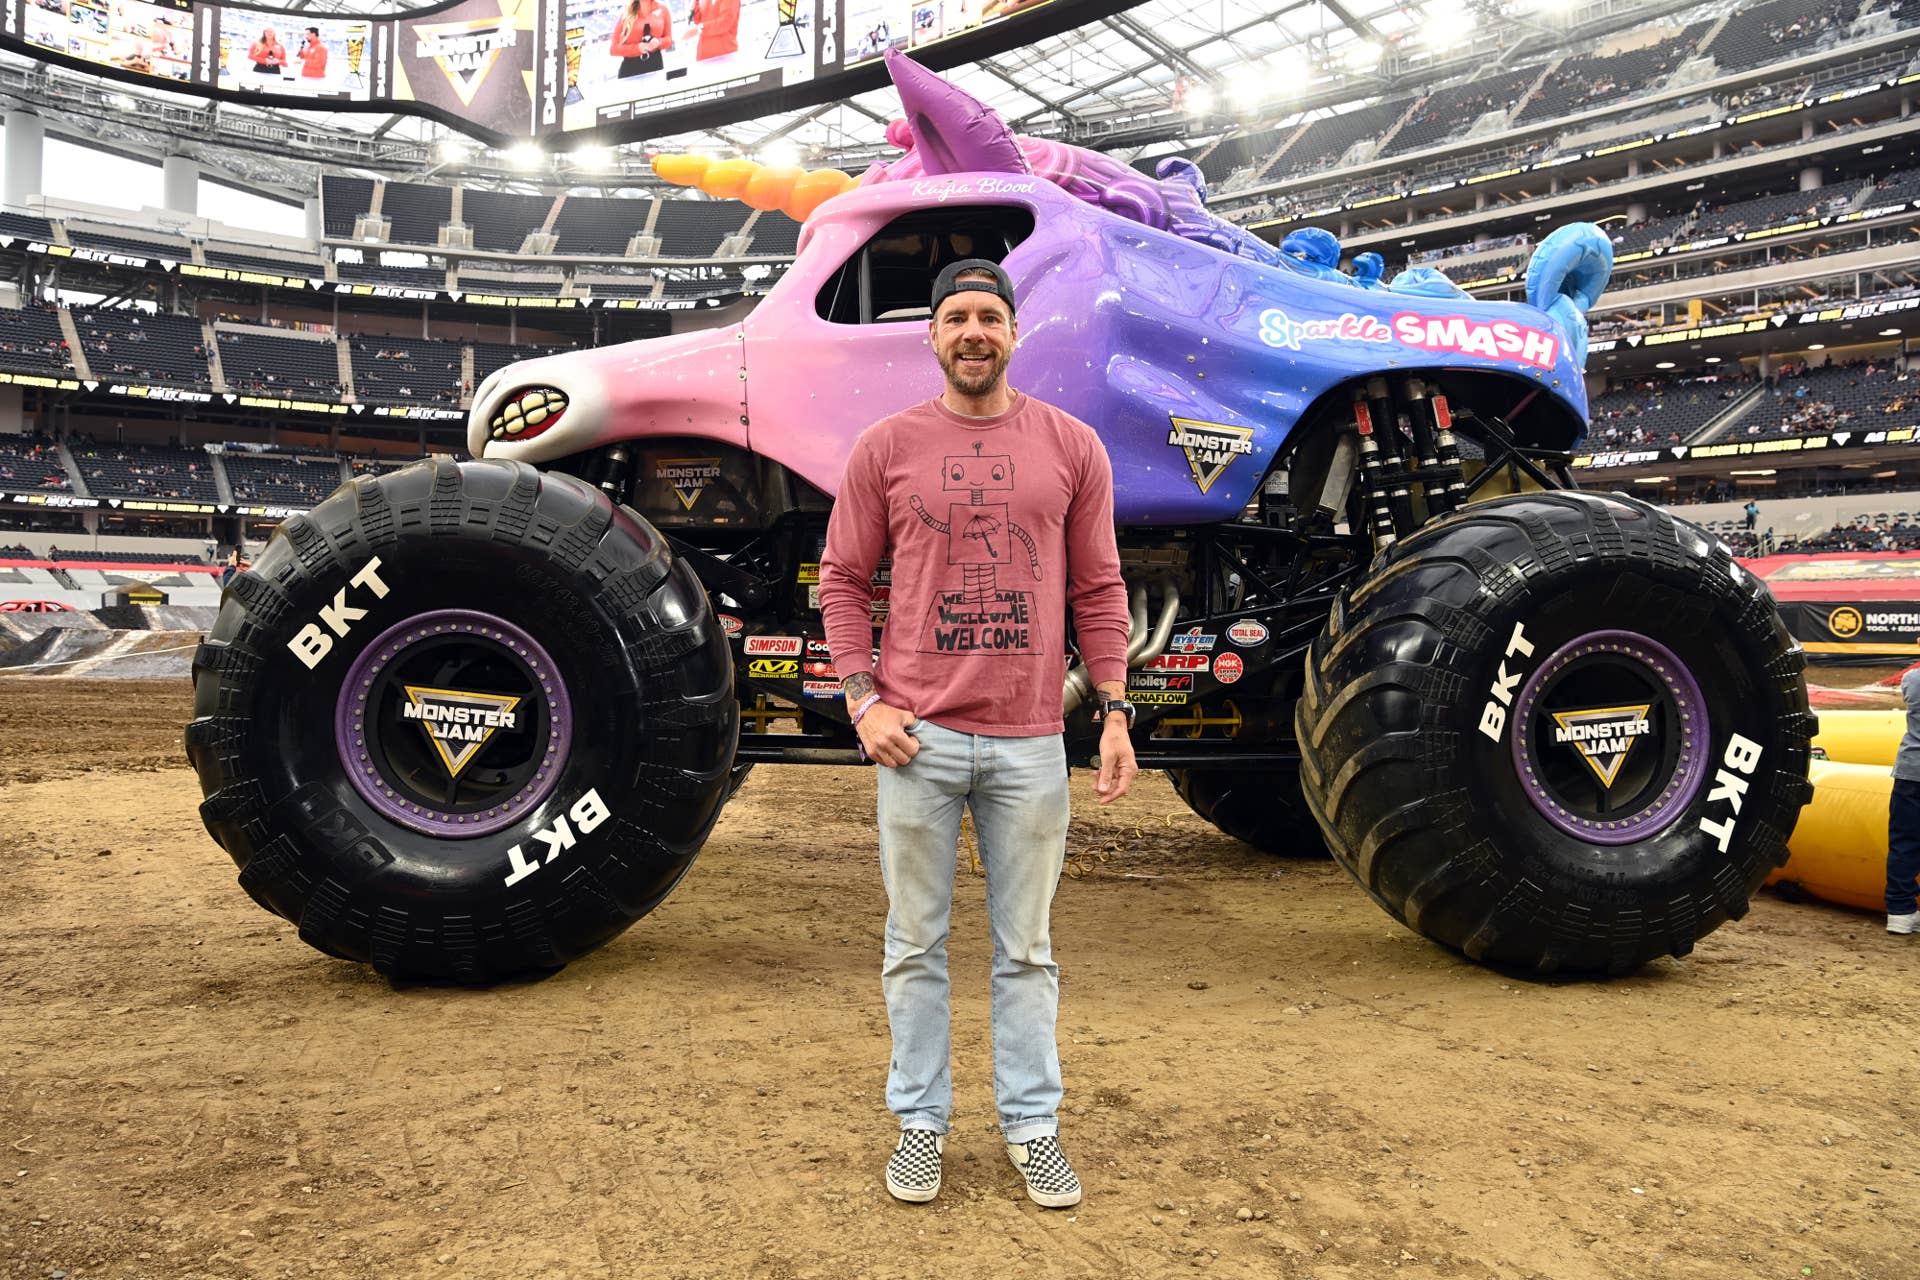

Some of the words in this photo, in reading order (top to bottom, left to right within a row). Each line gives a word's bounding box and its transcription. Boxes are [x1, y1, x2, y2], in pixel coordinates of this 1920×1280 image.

[910, 180, 970, 202] Kayla
[976, 177, 1037, 193] Blood
[1260, 309, 1392, 350] Sparkle
[1396, 316, 1554, 364] SMASH
[1168, 431, 1252, 455] MONSTER
[1190, 449, 1228, 466] JAM
[656, 467, 721, 479] MONSTER
[674, 478, 703, 488] JAM
[287, 555, 391, 670] BKT
[1866, 613, 1920, 625] NORTH
[934, 627, 1029, 651] WELCOME
[1174, 636, 1216, 645] SYSTEM
[1231, 629, 1249, 637] TOTAL
[1249, 629, 1264, 637] SEAL
[748, 640, 798, 653] SIMPSON
[1148, 655, 1208, 669] ARP
[1219, 659, 1238, 667] NGK
[1130, 675, 1168, 690] Holley
[1478, 621, 1536, 743] BKT
[1125, 693, 1186, 703] AGNAFLOW
[403, 701, 516, 729] MONSTER
[433, 722, 484, 742] JAM
[1555, 719, 1650, 743] MONSTER
[1584, 738, 1626, 755] JAM
[1698, 732, 1764, 853] BKT
[504, 787, 612, 887] BKT
